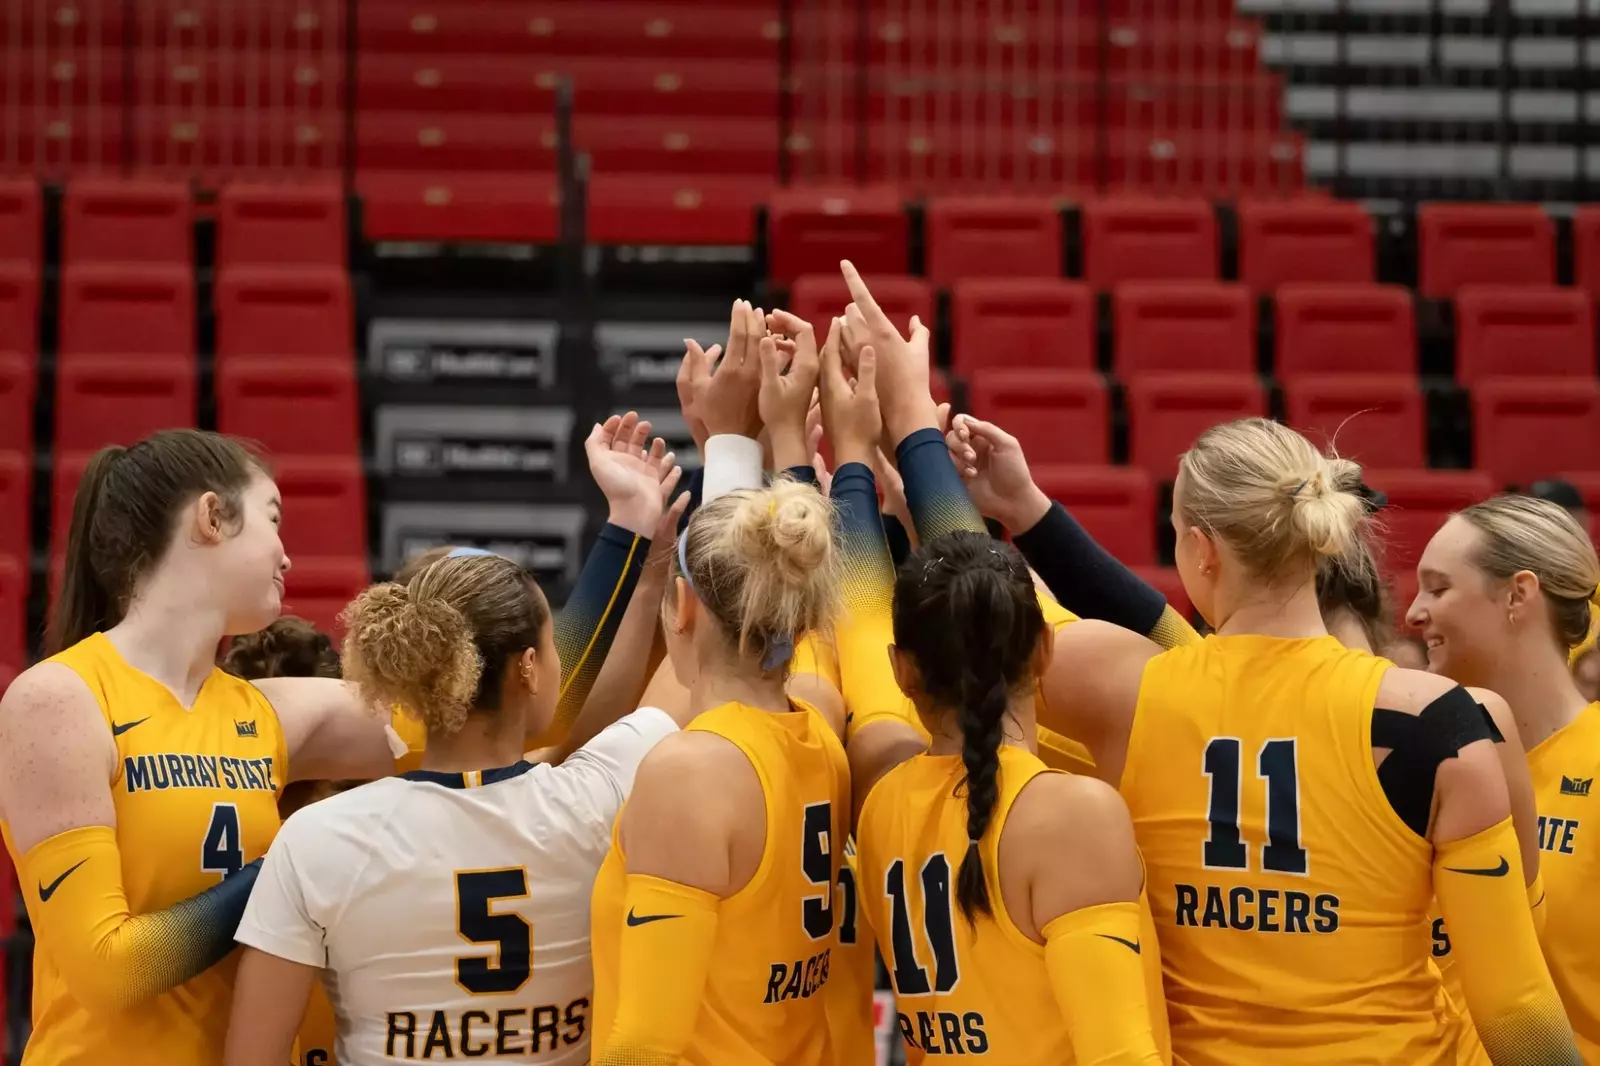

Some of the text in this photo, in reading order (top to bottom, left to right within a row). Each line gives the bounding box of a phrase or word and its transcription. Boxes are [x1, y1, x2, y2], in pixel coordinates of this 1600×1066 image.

[124, 753, 277, 793] MURRAY STATE
[1201, 735, 1310, 877] 11
[1537, 814, 1579, 856] ATE
[200, 802, 244, 880] 4
[801, 800, 833, 941] 9
[454, 865, 533, 996] 5
[1174, 883, 1341, 934] RACERS
[763, 947, 831, 1004] RACER
[385, 997, 590, 1060] RACERS
